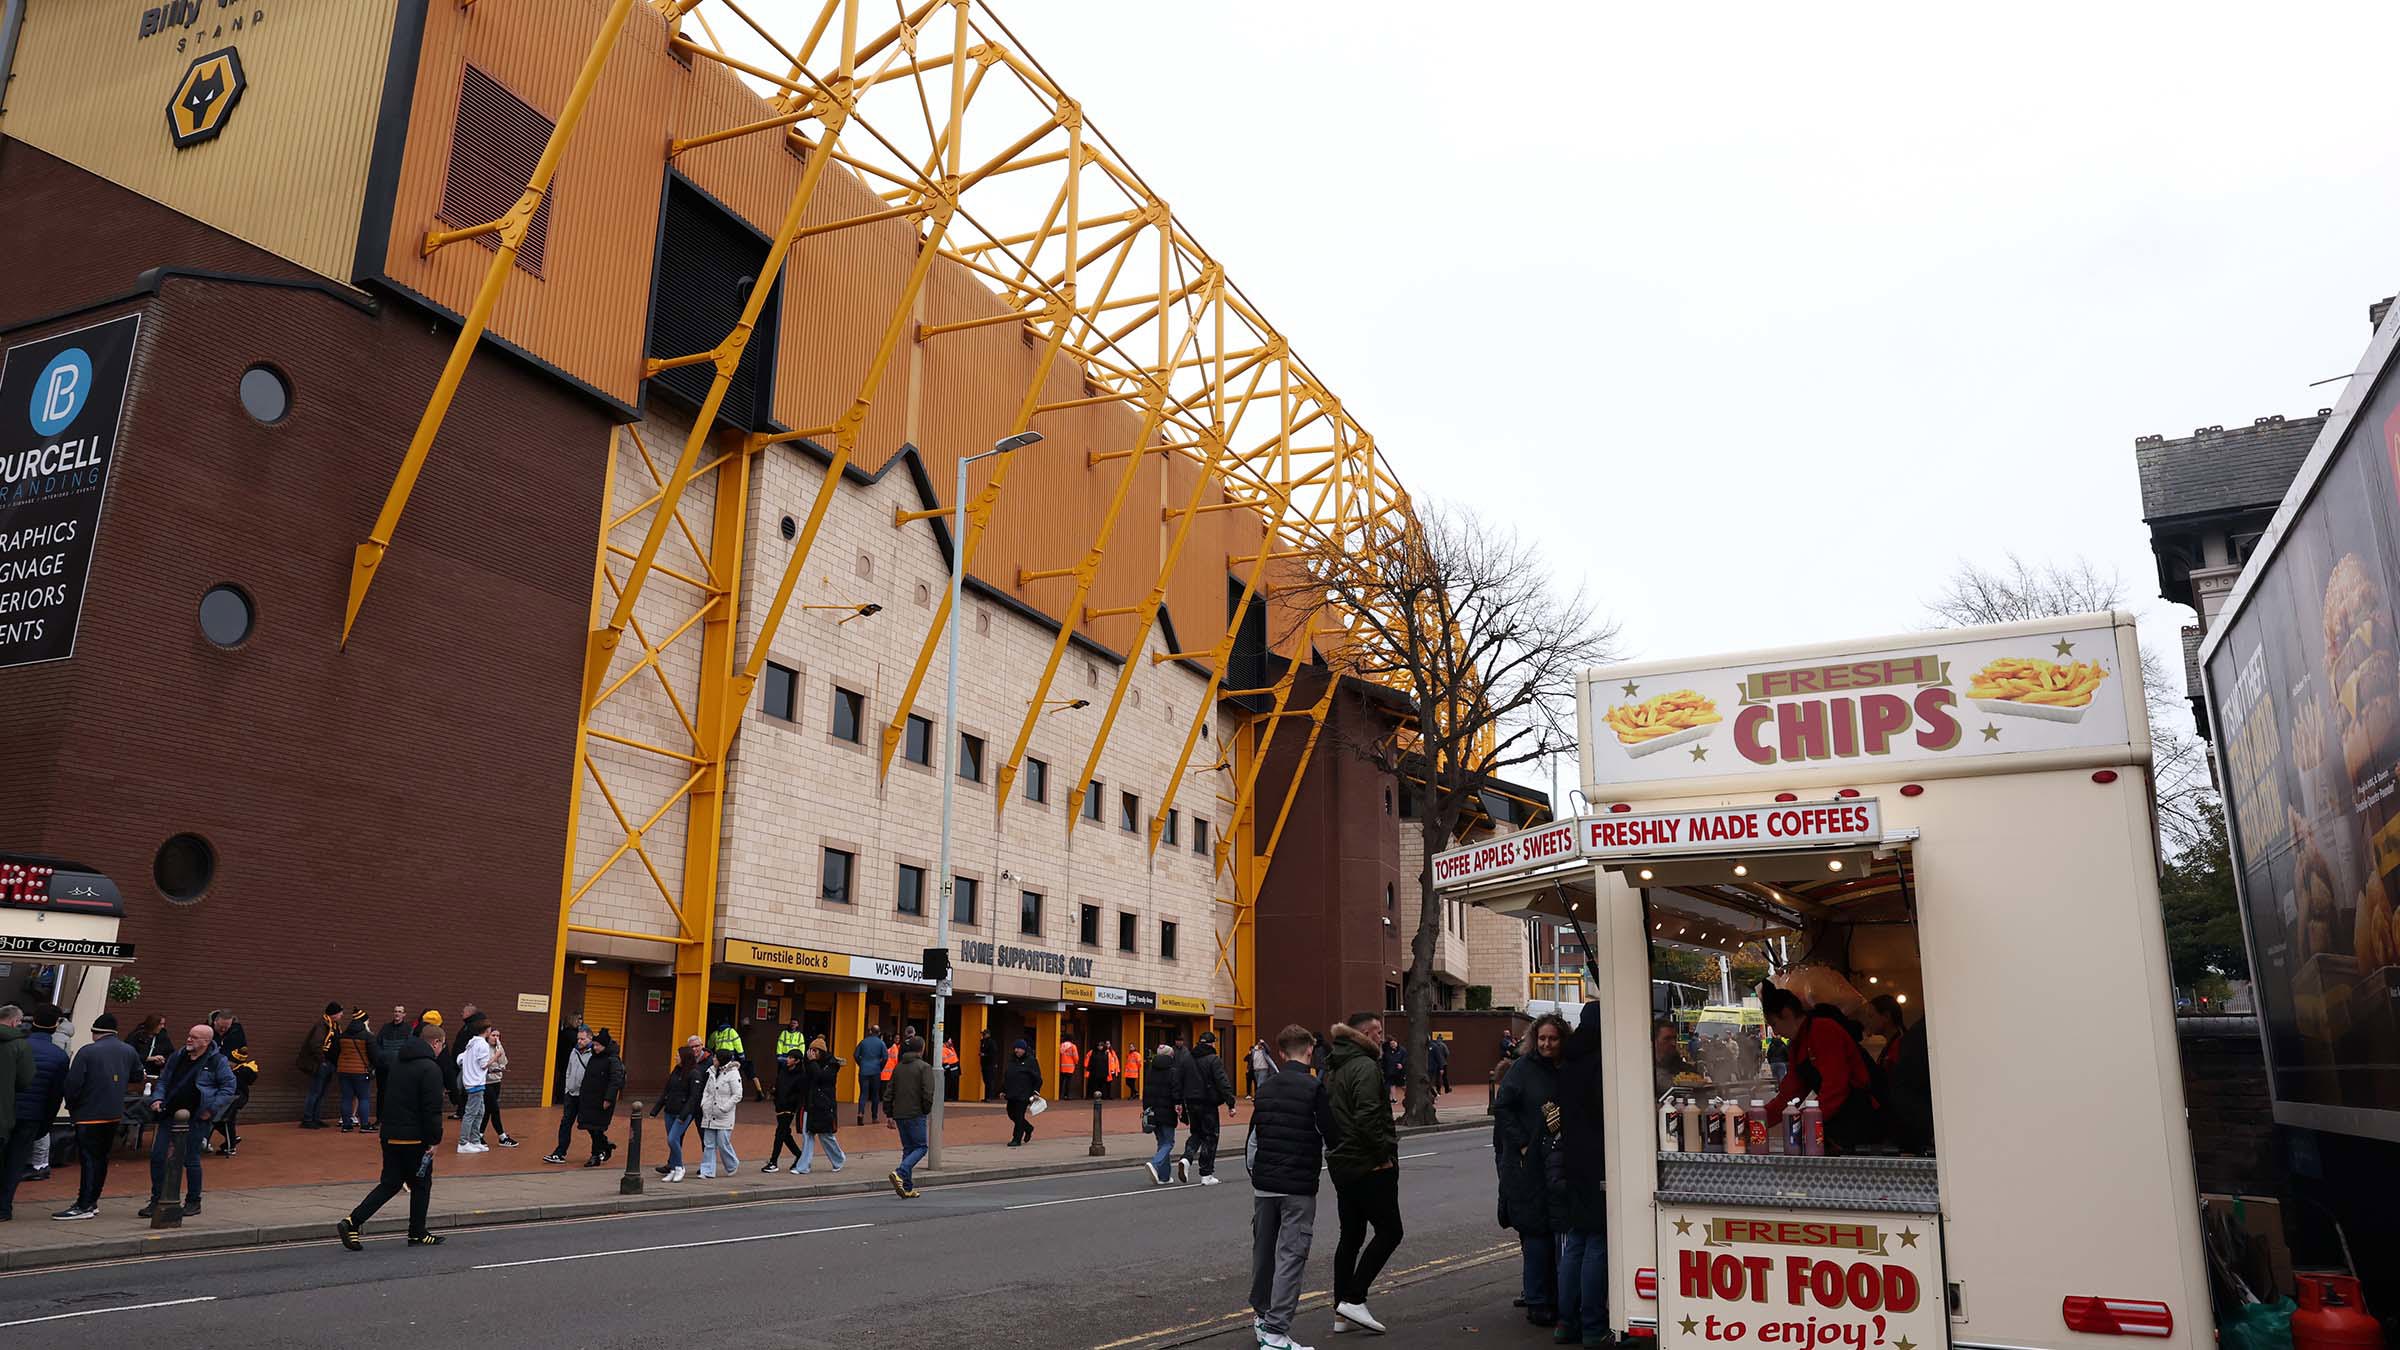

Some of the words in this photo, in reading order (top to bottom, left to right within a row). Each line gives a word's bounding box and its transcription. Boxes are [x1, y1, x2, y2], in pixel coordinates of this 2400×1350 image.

[138, 0, 201, 40] Billy
[176, 10, 265, 53] STAND
[1761, 657, 1924, 697] FRESH
[1733, 687, 1962, 765] CHIPS
[1591, 819, 1681, 848] FRESHLY
[1689, 813, 1759, 842] MADE
[1767, 806, 1870, 837] COFFEES
[1435, 853, 1470, 881] TOFFEE
[1474, 842, 1515, 872] APPLES
[1522, 827, 1572, 861] SWEETS
[40, 939, 121, 956] CHOCOLATE
[751, 946, 794, 965] Turnstile
[795, 952, 820, 968] Block
[822, 956, 829, 969] 8
[875, 962, 905, 978] W5-W9
[907, 965, 923, 982] Upp
[960, 939, 994, 966] HOME
[997, 944, 1065, 976] SUPPORTERS
[1068, 955, 1093, 979] ONLY
[1724, 1220, 1864, 1247] FRESH
[1679, 1249, 1774, 1304] HOT
[1786, 1255, 1921, 1313] FOOD
[1705, 1314, 1747, 1342] to
[1757, 1314, 1887, 1350] enjoy!
